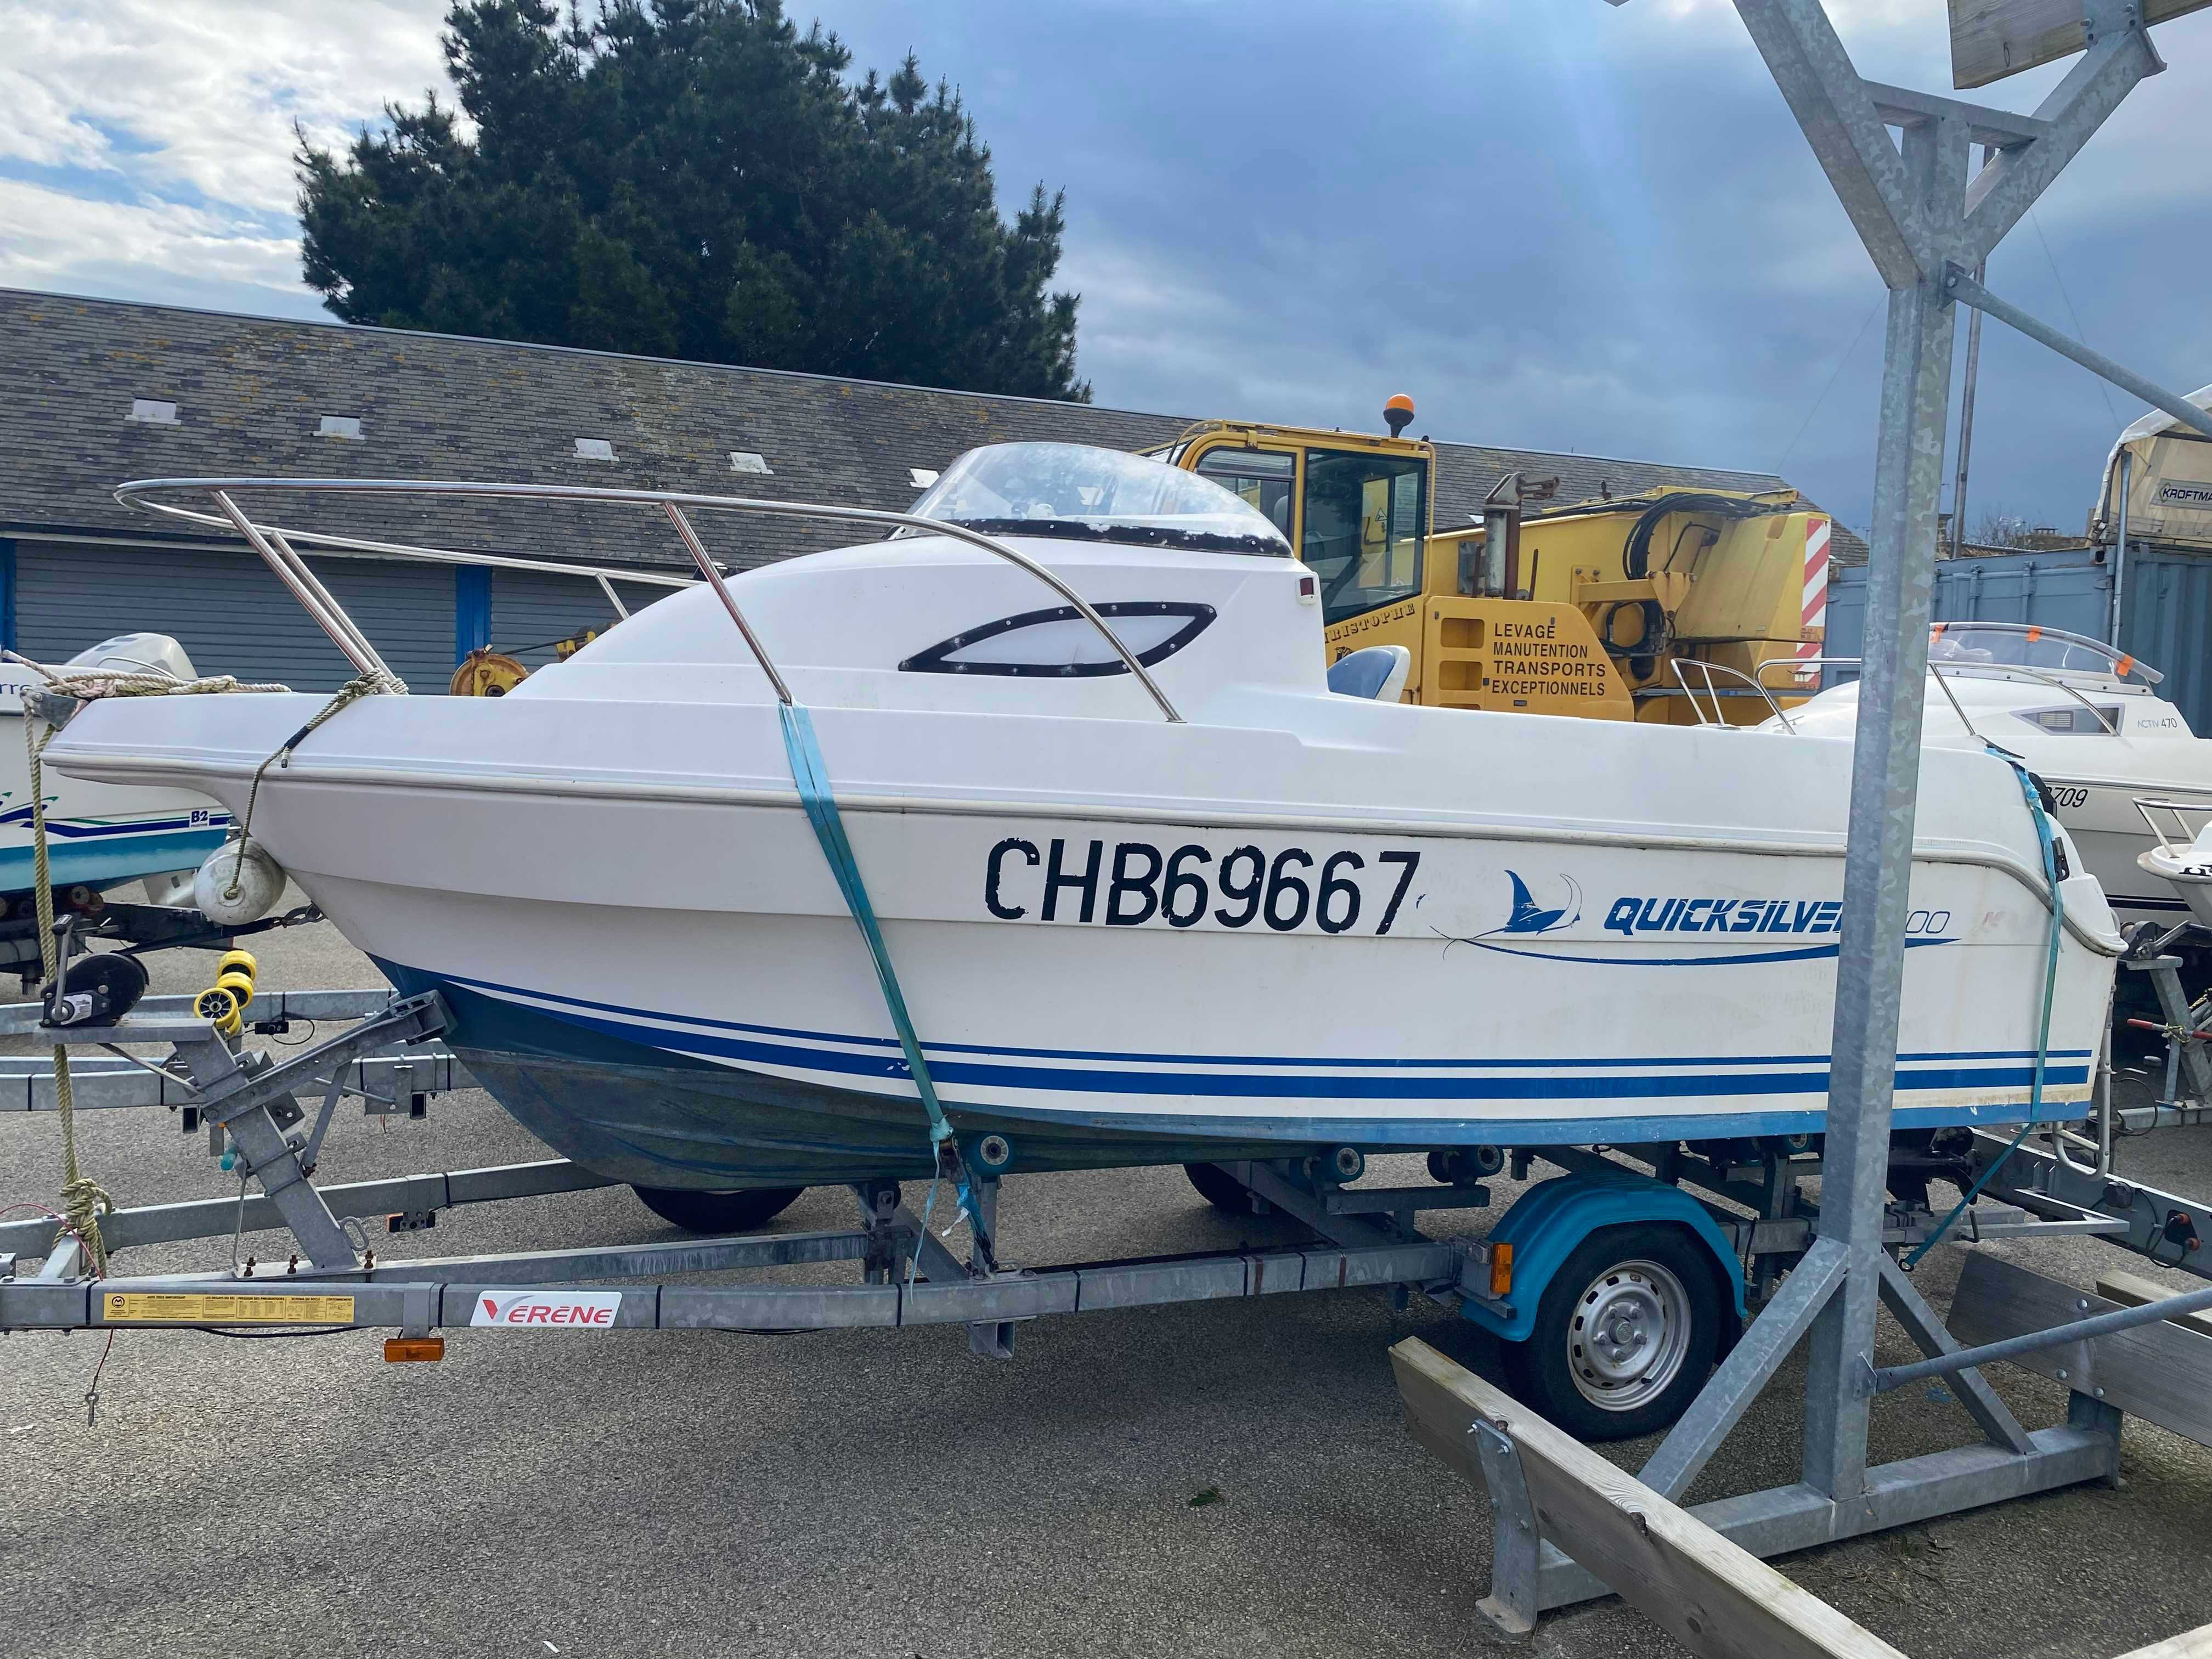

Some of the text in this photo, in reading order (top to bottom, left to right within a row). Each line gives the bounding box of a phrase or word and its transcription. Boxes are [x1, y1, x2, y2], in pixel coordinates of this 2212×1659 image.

[1494, 623, 1555, 639] LEVAGE
[1493, 642, 1588, 658] MANUTENTION
[1493, 661, 1605, 677] TRANSPORTS
[1492, 680, 1605, 696] EXCEPTIONNELS
[2161, 718, 2177, 728] 470
[191, 810, 208, 823] B2
[985, 837, 1421, 935] CHB69667
[1604, 897, 1843, 935] QUICKSILVE
[1905, 910, 1950, 934] 00
